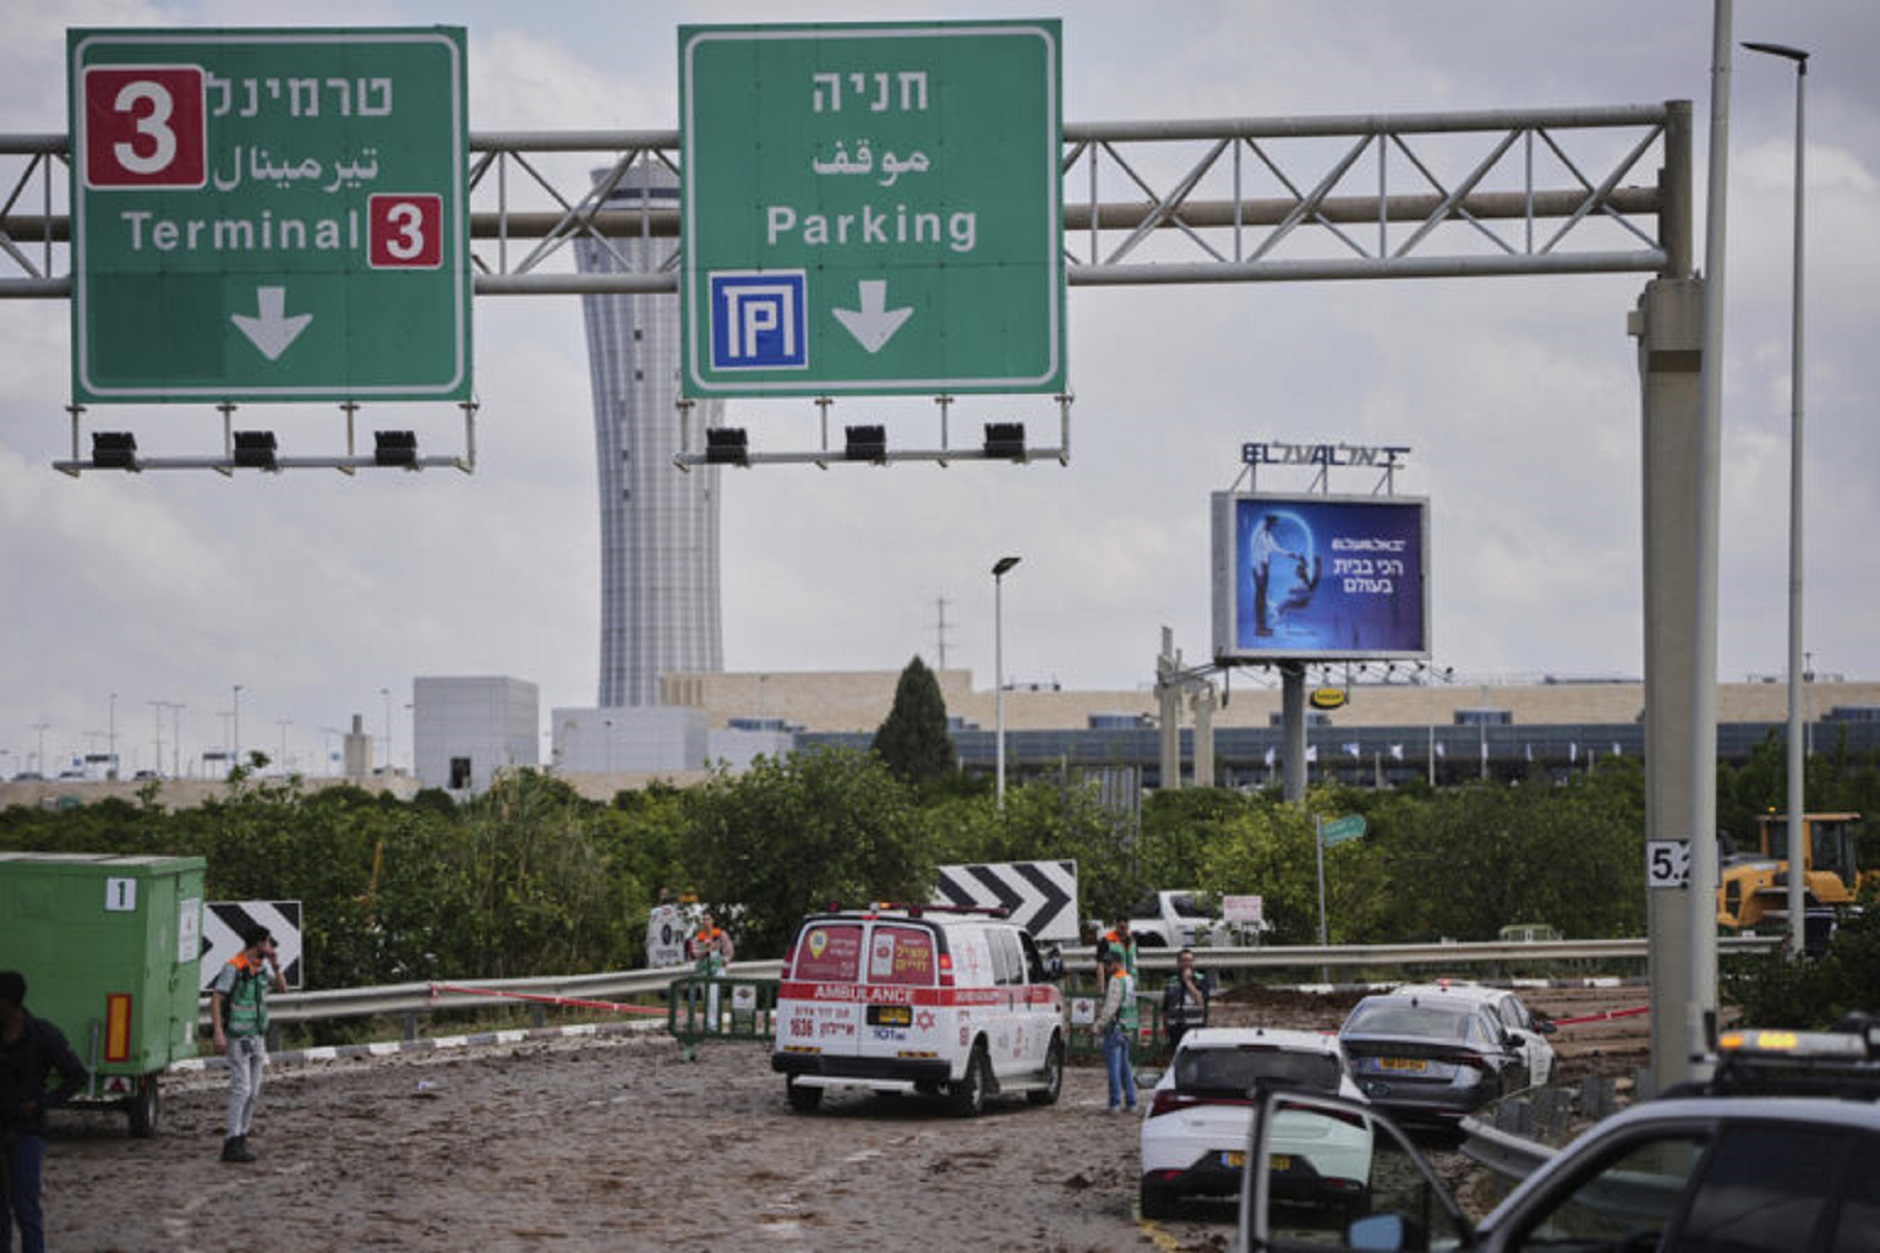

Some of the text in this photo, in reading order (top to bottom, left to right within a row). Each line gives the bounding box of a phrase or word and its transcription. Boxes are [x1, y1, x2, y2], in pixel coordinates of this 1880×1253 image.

[204, 71, 393, 117] טרמינל
[812, 71, 928, 113] חניה
[113, 80, 178, 175] 3
[213, 145, 379, 193] تيرمينال
[812, 139, 931, 187] موقف
[121, 202, 424, 259] Terminal 3
[767, 205, 977, 253] Parking
[1333, 558, 1405, 577] הכי בבית
[118, 880, 126, 907] 1
[813, 984, 914, 1004] AMBULANCE
